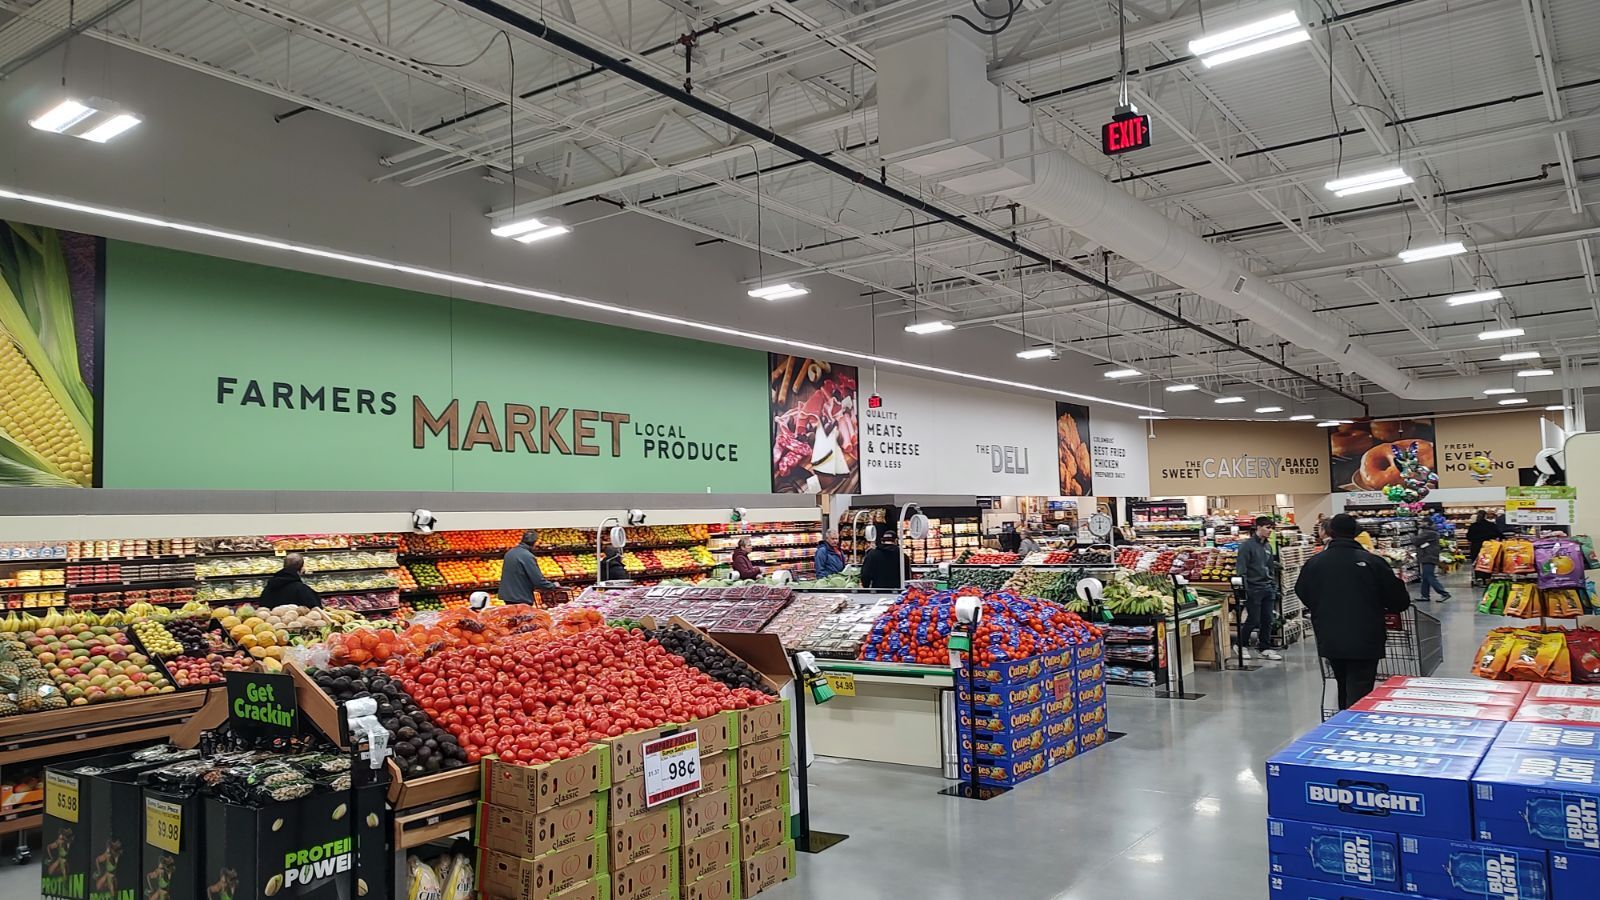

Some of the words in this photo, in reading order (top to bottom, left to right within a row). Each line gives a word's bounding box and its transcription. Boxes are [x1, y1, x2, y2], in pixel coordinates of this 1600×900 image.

[1109, 117, 1143, 151] EXIT
[217, 376, 397, 416] FARMERS
[866, 410, 898, 420] QUALITY
[412, 394, 631, 458] MARKET
[635, 422, 686, 439] LOCAL
[867, 423, 902, 438] MEATS
[644, 439, 738, 462] PRODUCE
[867, 441, 875, 453] &
[879, 441, 920, 456] CHEESE
[976, 445, 990, 455] THE
[867, 459, 882, 469] FOR
[884, 459, 902, 469] LESS
[990, 444, 1029, 475] DELI
[1202, 457, 1282, 479] CAKERY
[1286, 458, 1319, 468] BAKED
[1162, 468, 1201, 479] SWEET
[1290, 467, 1319, 475] BREADS
[1009, 664, 1029, 678] Cuties
[246, 682, 275, 703] Get
[960, 691, 986, 701] Cuies
[1009, 690, 1029, 704] Cuties
[234, 698, 295, 729] Crackin'
[961, 715, 988, 726] Cuies
[1011, 713, 1031, 728] Cuties
[1012, 736, 1032, 751] Cuties
[668, 757, 696, 780] 98¢
[1013, 760, 1033, 776] Cuties
[1554, 757, 1595, 784] LIGHT
[528, 775, 536, 807] classic
[1309, 785, 1354, 804] BUD
[1355, 790, 1420, 812] LIGHT
[57, 793, 77, 811] $5.98
[158, 820, 179, 841] $9.98
[1566, 804, 1583, 840] BUD
[1580, 798, 1600, 849] LIGHT
[1343, 841, 1358, 874] BUD
[1356, 836, 1372, 882] LIGHT
[1486, 859, 1504, 894] BUD
[1500, 854, 1519, 900] LIGHT
